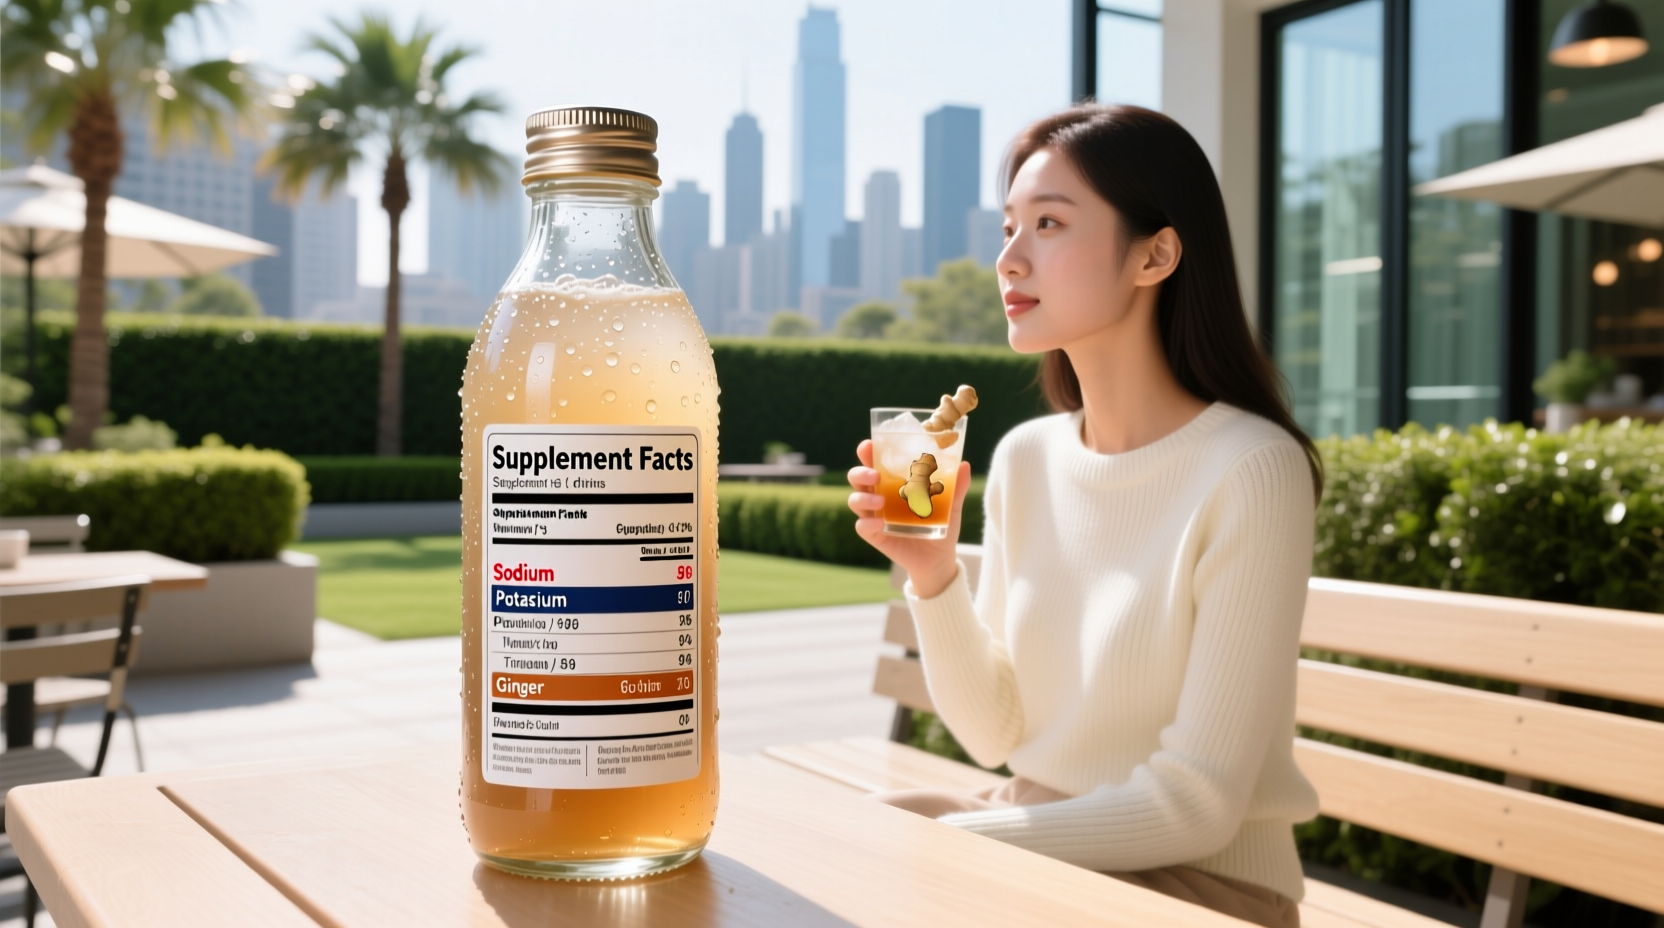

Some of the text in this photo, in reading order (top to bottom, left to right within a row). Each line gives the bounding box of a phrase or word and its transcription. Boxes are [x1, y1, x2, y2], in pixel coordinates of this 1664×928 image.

[493, 445, 694, 476] Supplement Facts
[493, 563, 555, 582] Sodium
[495, 590, 567, 608] Potasium
[496, 677, 545, 698] Ginger
